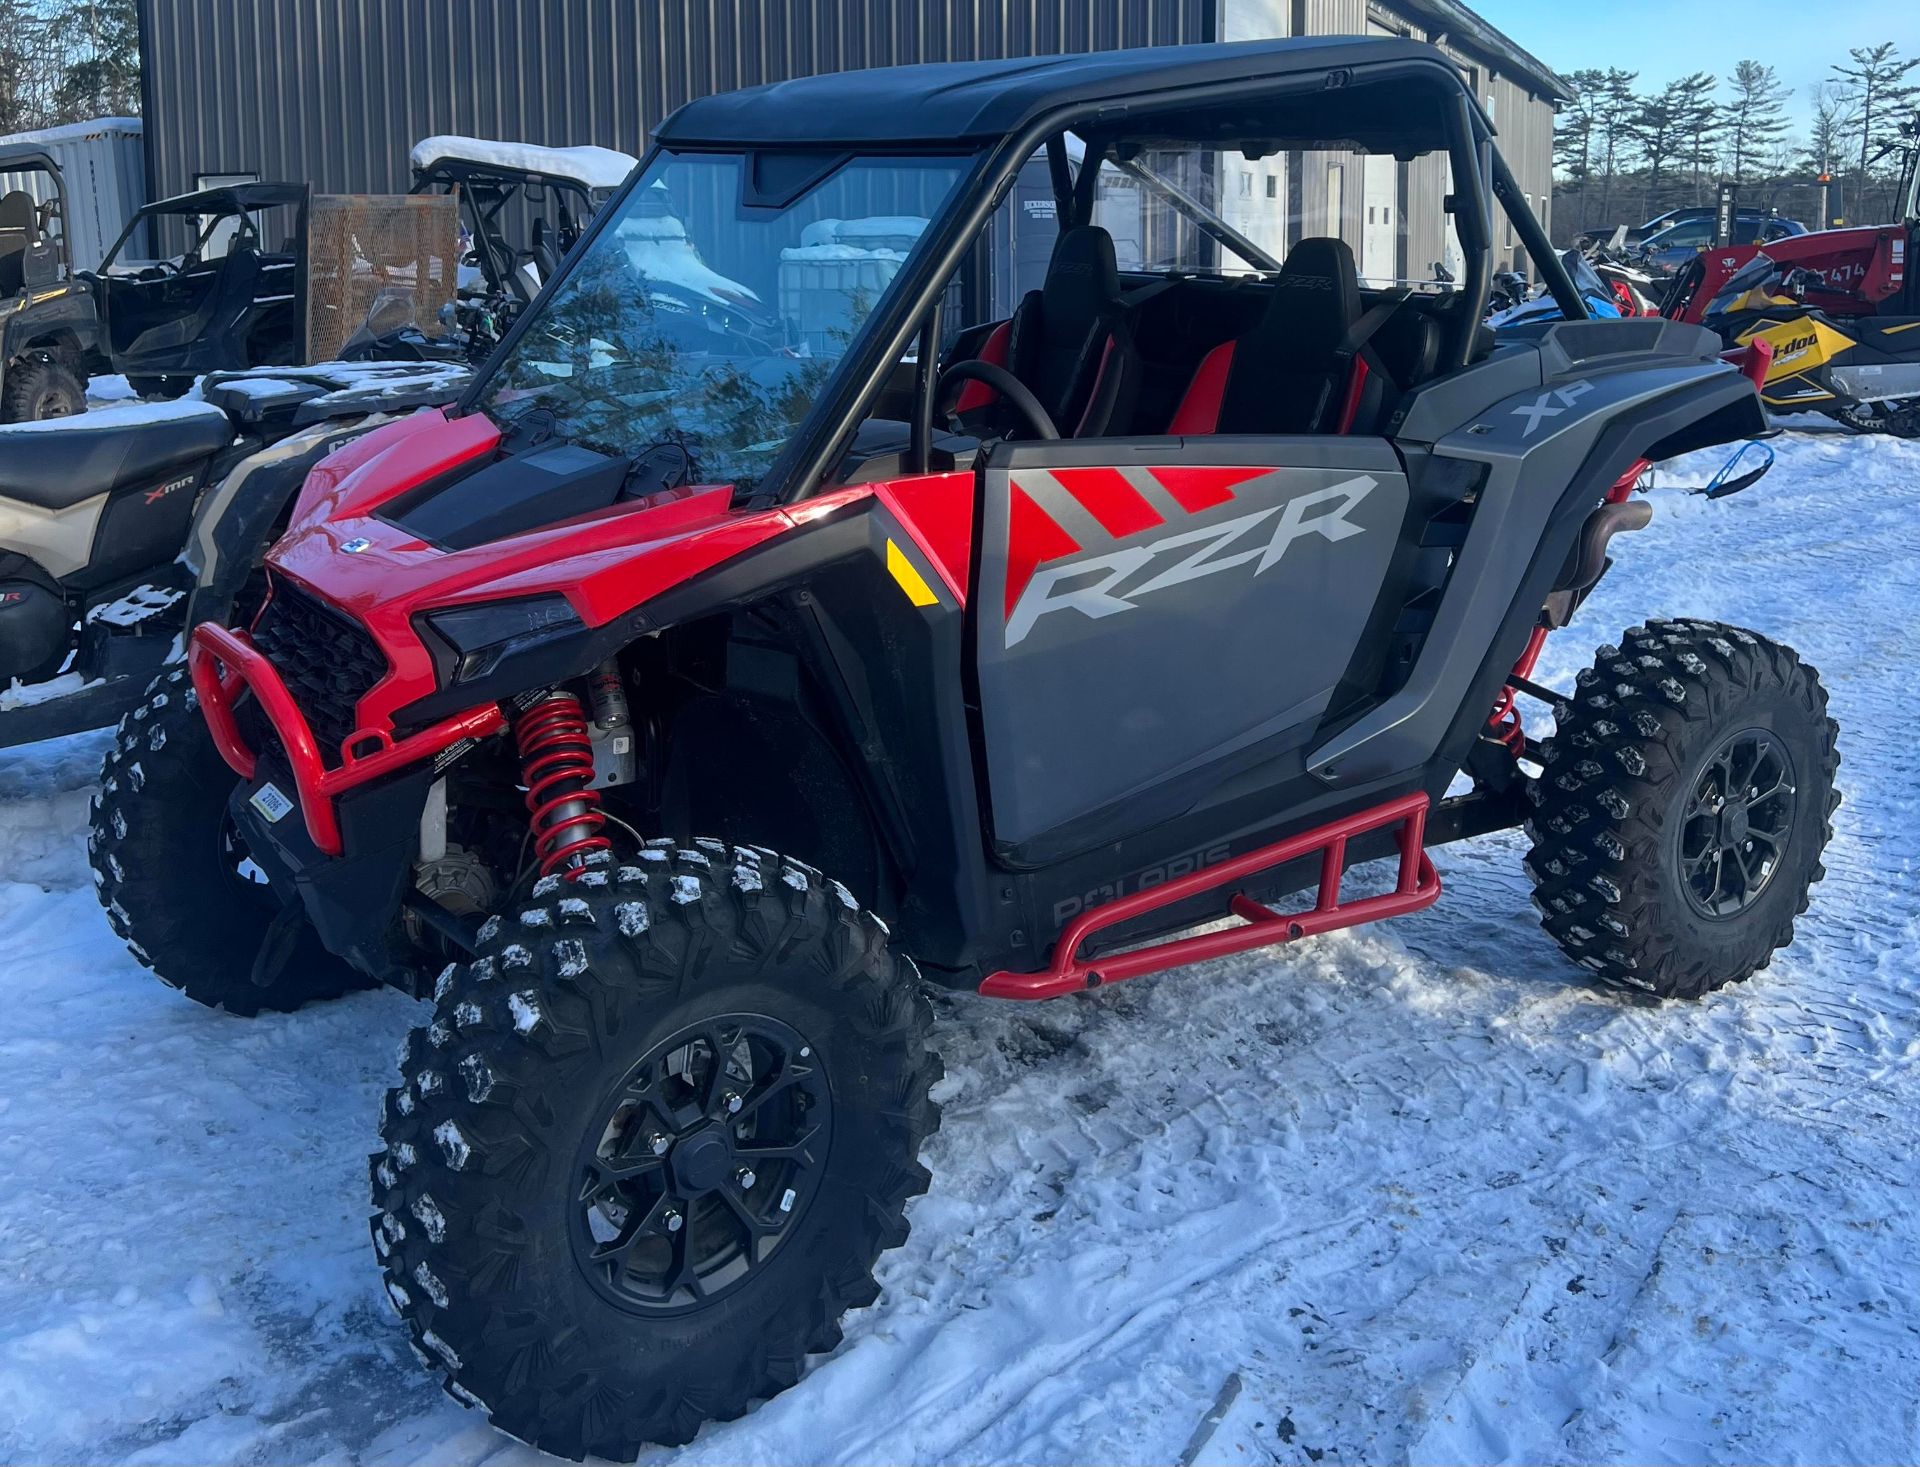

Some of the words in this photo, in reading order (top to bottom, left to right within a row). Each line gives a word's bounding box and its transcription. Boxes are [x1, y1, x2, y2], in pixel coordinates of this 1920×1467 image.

[1771, 333, 1819, 360] i-doo
[1510, 379, 1595, 439] XP
[144, 475, 194, 505] XMR
[1005, 475, 1379, 650] RZR
[434, 738, 468, 763] OLARIS
